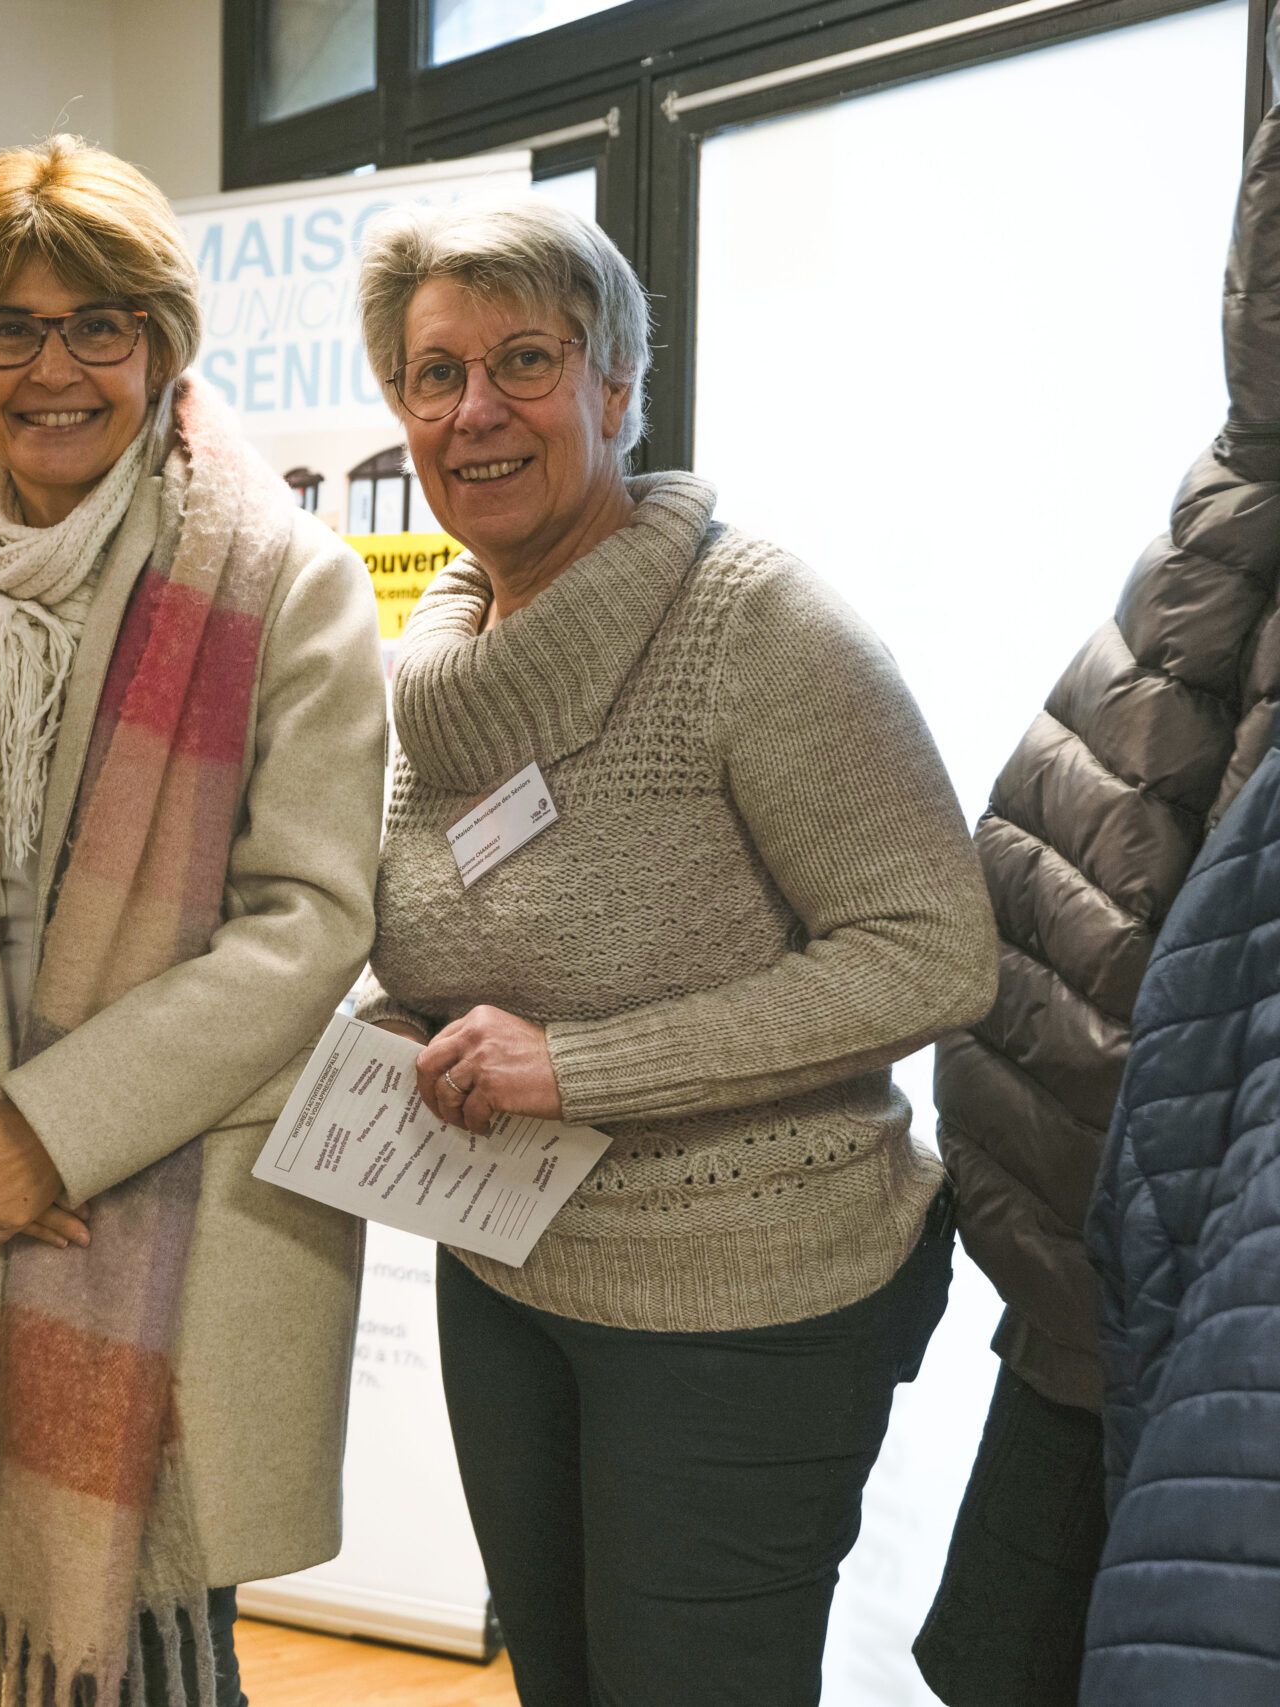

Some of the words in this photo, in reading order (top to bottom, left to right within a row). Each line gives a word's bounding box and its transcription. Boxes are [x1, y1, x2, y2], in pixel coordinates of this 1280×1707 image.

[455, 824, 473, 840] Maison
[474, 802, 501, 825] Municipale
[502, 794, 511, 803] des
[349, 1065, 372, 1093] Ramassage
[358, 1063, 382, 1095] champignons
[381, 1065, 395, 1093] Exposition
[392, 1072, 402, 1090] photos
[292, 1111, 308, 1138] ENTOUREZ
[308, 1083, 322, 1107] ACTIVITES
[320, 1052, 339, 1082] PRINCIPALES
[305, 1116, 313, 1126] QUE
[311, 1102, 320, 1115] VOUS
[395, 1111, 408, 1135] Assister
[314, 1148, 327, 1170] Balades
[326, 1123, 337, 1141] visites
[338, 1130, 350, 1154] environs
[356, 1127, 370, 1142] Partie
[382, 1147, 396, 1163] fleurs
[489, 1162, 497, 1173] soir
[358, 1163, 377, 1187] Cueillette
[381, 1184, 395, 1199] Sortie
[394, 1160, 412, 1184] culturelle
[444, 1180, 461, 1198] Escape
[458, 1165, 472, 1179] Game
